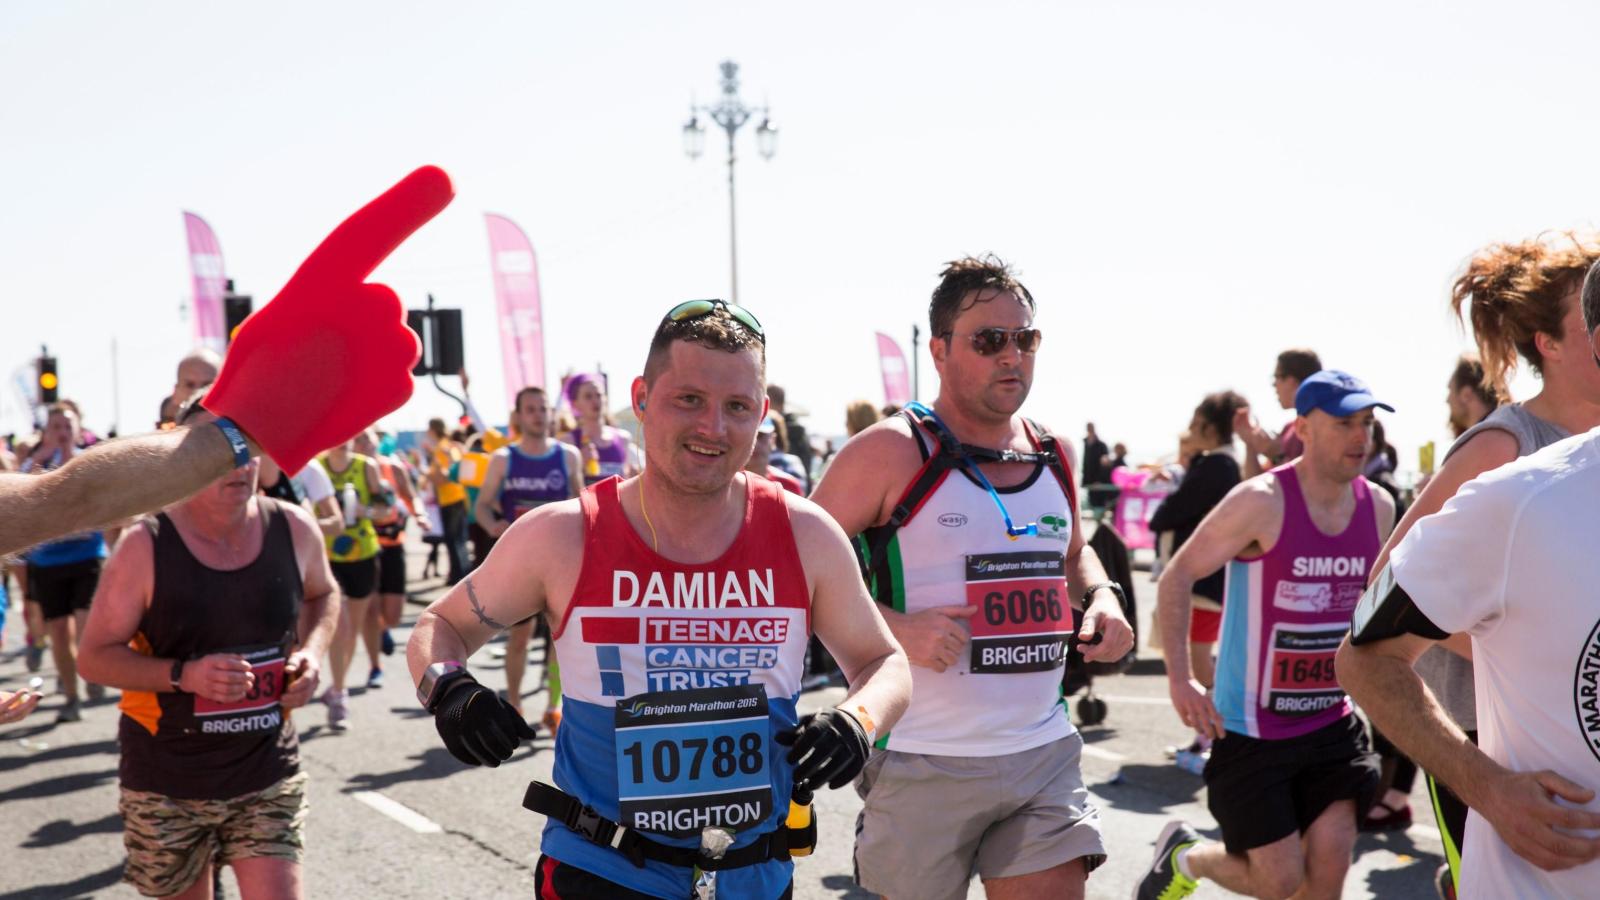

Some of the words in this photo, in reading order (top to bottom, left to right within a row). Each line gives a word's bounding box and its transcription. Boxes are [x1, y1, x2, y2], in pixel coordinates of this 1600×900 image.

[1292, 557, 1365, 577] SIMON
[612, 568, 775, 610] DAMIAN
[984, 588, 1062, 626] 6066
[649, 619, 788, 642] TEENAGE
[648, 647, 777, 669] CANCER
[649, 671, 749, 692] TRUST
[1277, 658, 1335, 683] 1649
[643, 703, 687, 716] Brighton
[688, 700, 735, 712] Marathon
[737, 697, 758, 708] 2015
[201, 711, 280, 733] BRIGHTON
[623, 732, 763, 784] 10788
[634, 801, 761, 831] BRIGHTON
